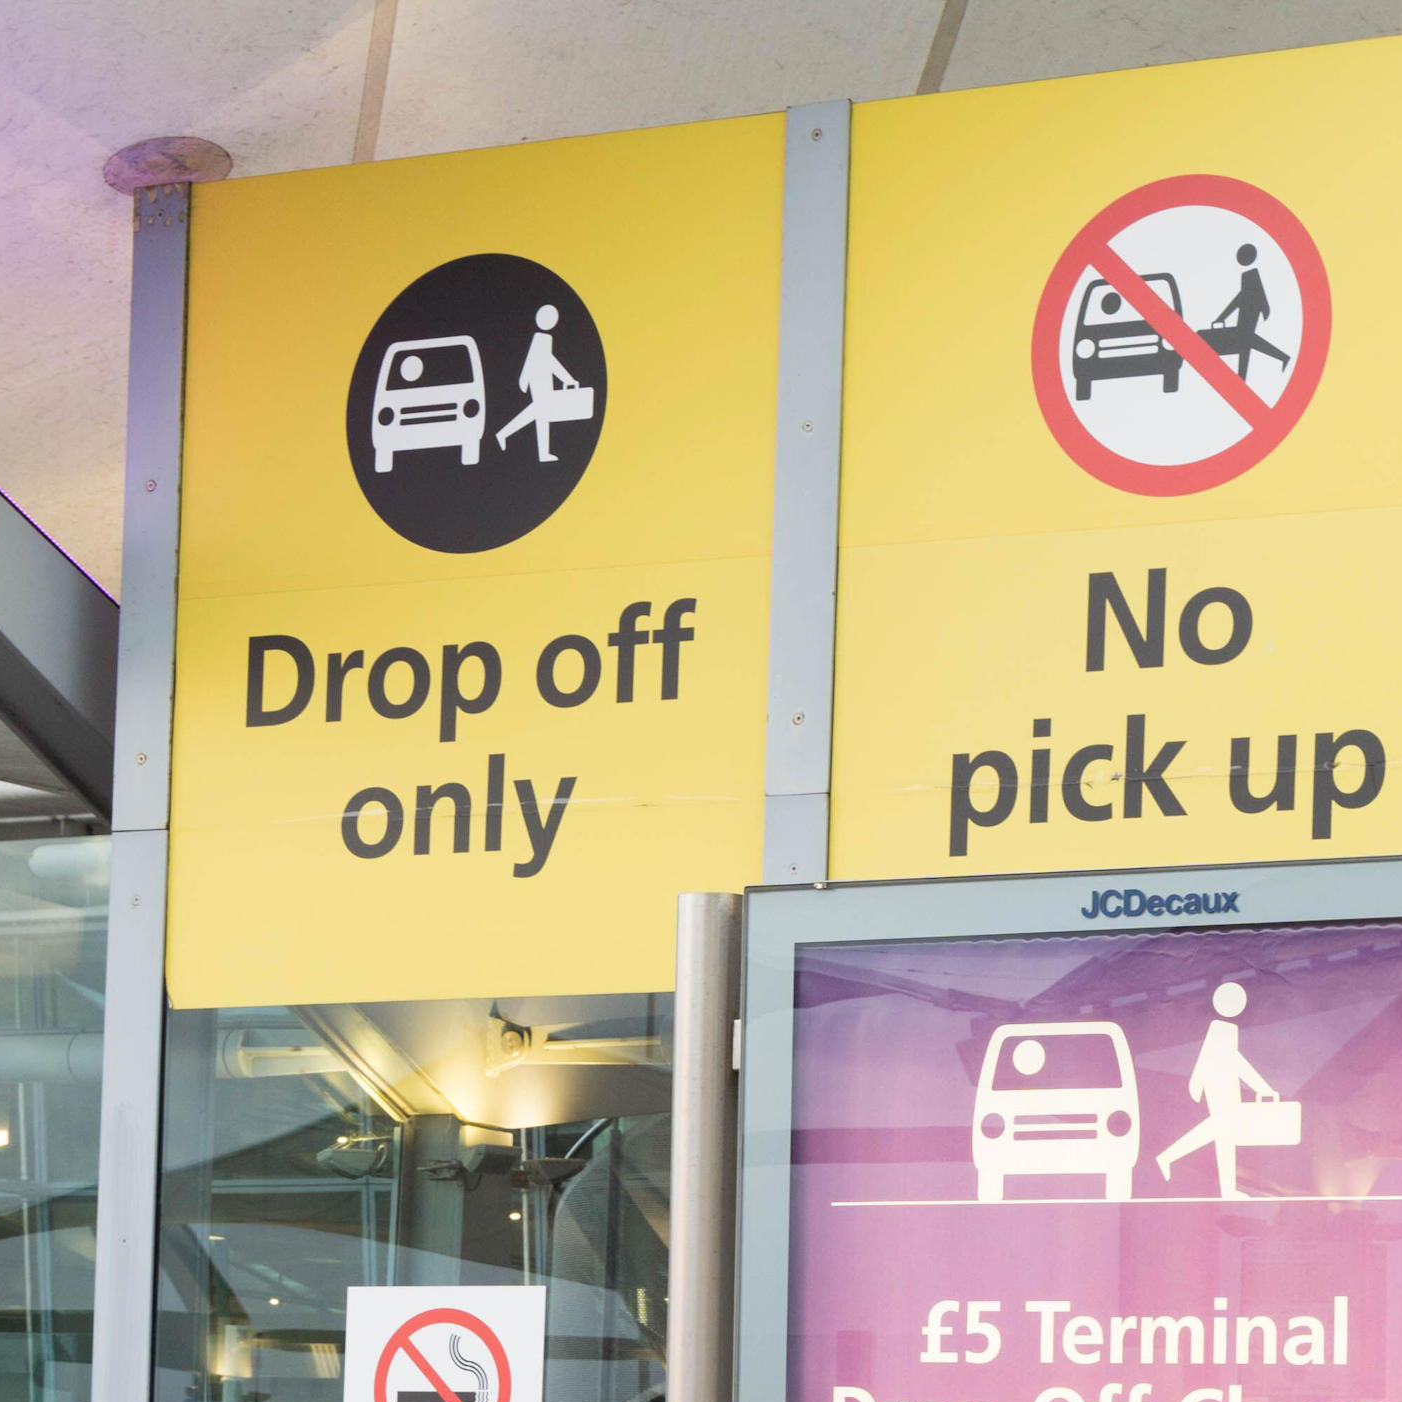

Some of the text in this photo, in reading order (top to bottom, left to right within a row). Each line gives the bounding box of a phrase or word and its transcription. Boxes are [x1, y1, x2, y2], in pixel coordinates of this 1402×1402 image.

[244, 599, 696, 743] Drop off
[1085, 568, 1254, 673] No
[340, 754, 577, 878] only
[949, 715, 1387, 857] pick up
[1081, 889, 1240, 919] JCDecaux
[919, 1295, 1349, 1366] £5 Terminal
